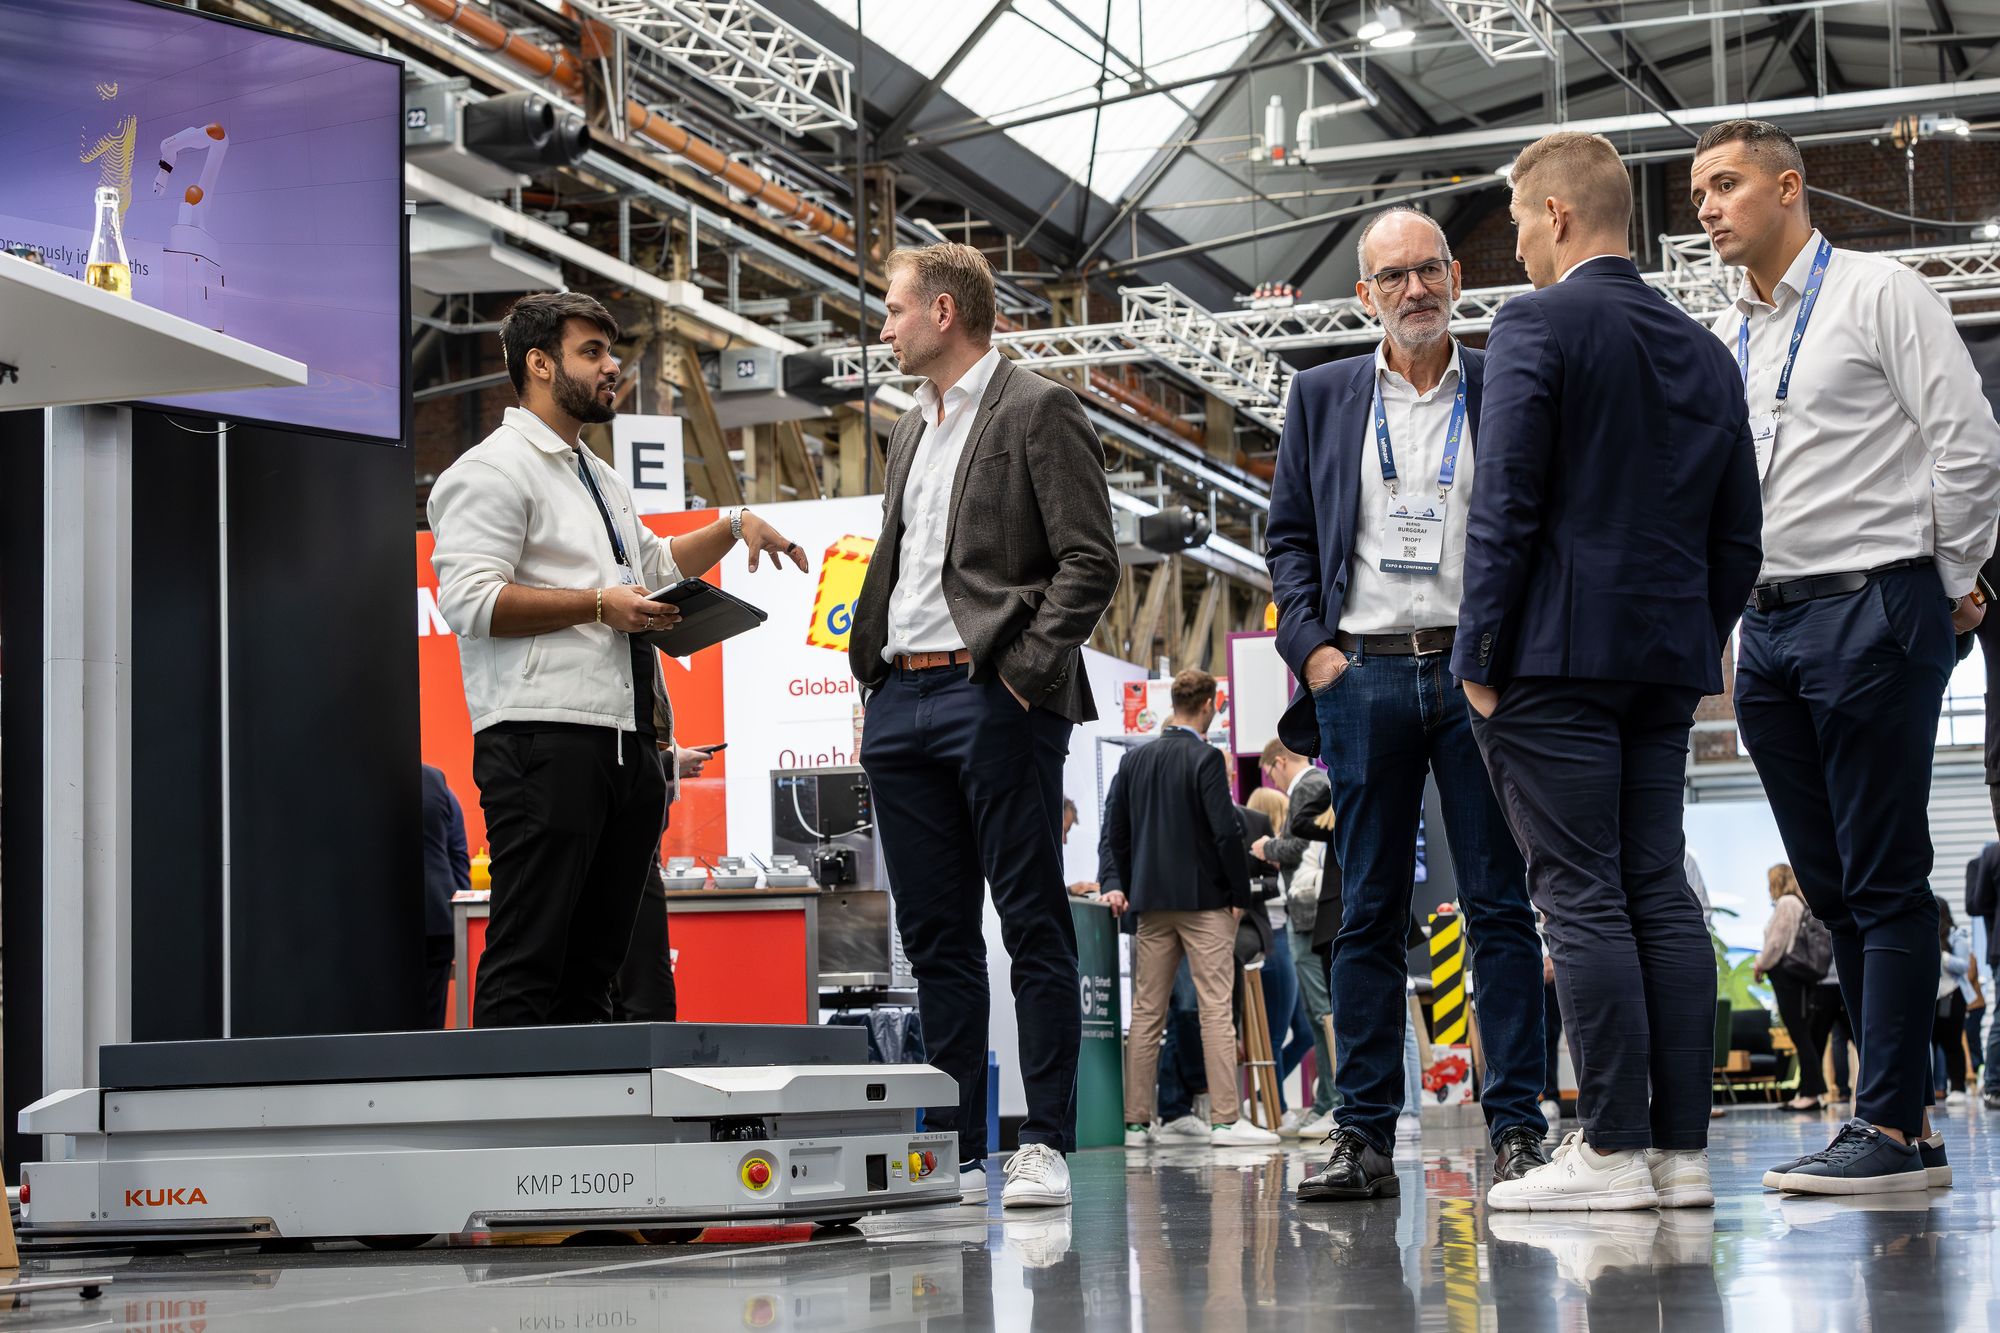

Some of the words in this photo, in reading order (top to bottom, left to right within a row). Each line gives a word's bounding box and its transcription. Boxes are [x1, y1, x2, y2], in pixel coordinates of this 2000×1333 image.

[408, 110, 426, 127] 22
[632, 442, 667, 490] E
[1397, 526, 1428, 534] BURGGRAF
[1403, 564, 1433, 572] CONFERENCE
[789, 676, 855, 697] Global
[517, 1174, 563, 1195] KMP
[570, 1173, 634, 1194] 1500P
[125, 1188, 208, 1207] KUKA
